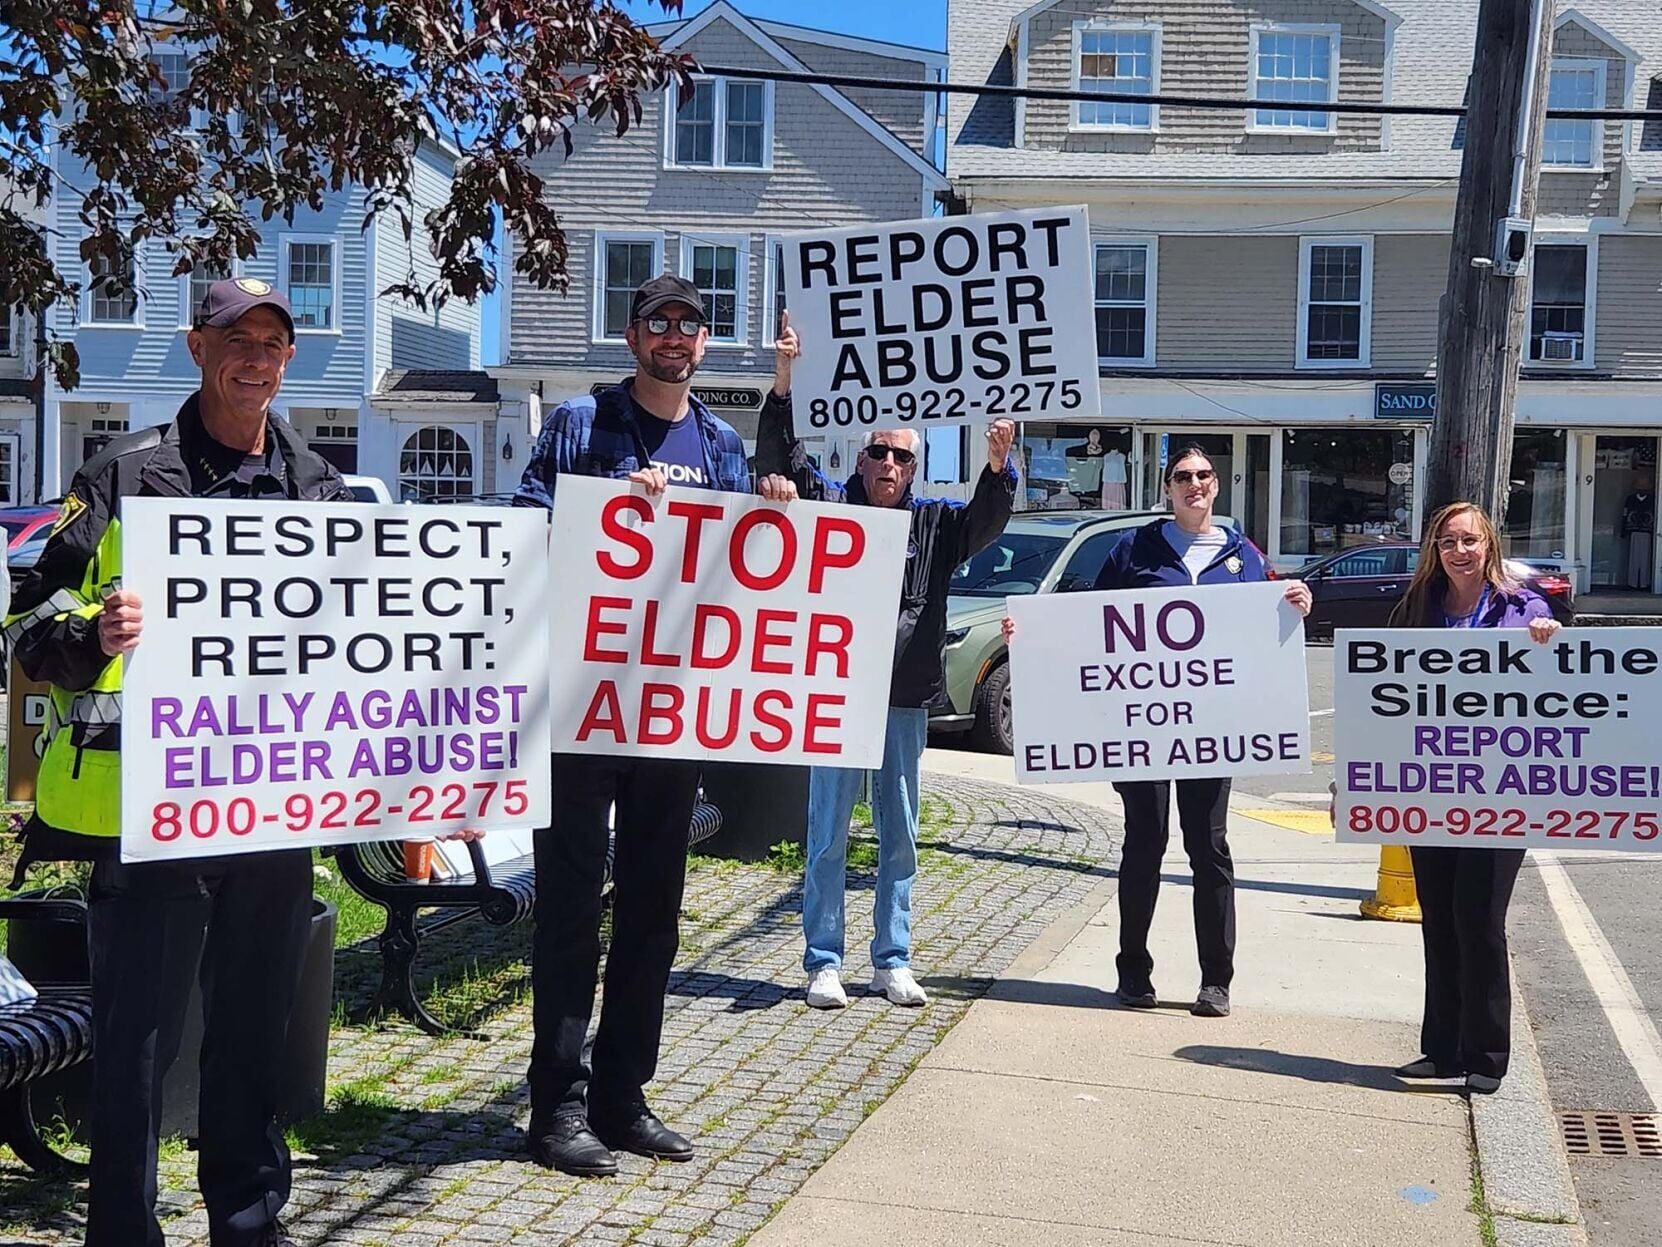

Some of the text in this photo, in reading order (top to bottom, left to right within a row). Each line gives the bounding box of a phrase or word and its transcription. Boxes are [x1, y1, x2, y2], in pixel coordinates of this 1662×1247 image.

[800, 218, 1070, 288] REPORT
[830, 276, 1046, 338] ELDER
[831, 327, 1056, 391] ABUSE
[697, 391, 751, 404] DING CO.
[810, 380, 1081, 427] 800-922-2275
[1381, 393, 1425, 409] SAND
[649, 460, 702, 484] TION
[1234, 473, 1241, 485] 9
[1585, 474, 1593, 486] 9
[170, 514, 511, 566] RESPECT,
[596, 495, 866, 593] STOP
[167, 577, 514, 624] PROTECT,
[583, 596, 854, 678] ELDER
[1103, 600, 1205, 653] NO
[192, 632, 495, 677] REPORT:
[1080, 658, 1235, 692] EXCUSE
[1348, 640, 1659, 675] Break the
[152, 685, 527, 738] RALLY AGAINST
[576, 681, 846, 754] ABUSE
[1126, 701, 1193, 727] FOR
[1371, 683, 1629, 718] Silence:
[165, 731, 518, 789] ELDER ABUSE!
[1025, 733, 1301, 772] ELDER ABUSE
[1414, 726, 1591, 758] REPORT
[1347, 761, 1660, 798] ELDER ABUSE!
[151, 780, 528, 842] 800-922-2275
[1348, 805, 1659, 841] 800-922-2275
